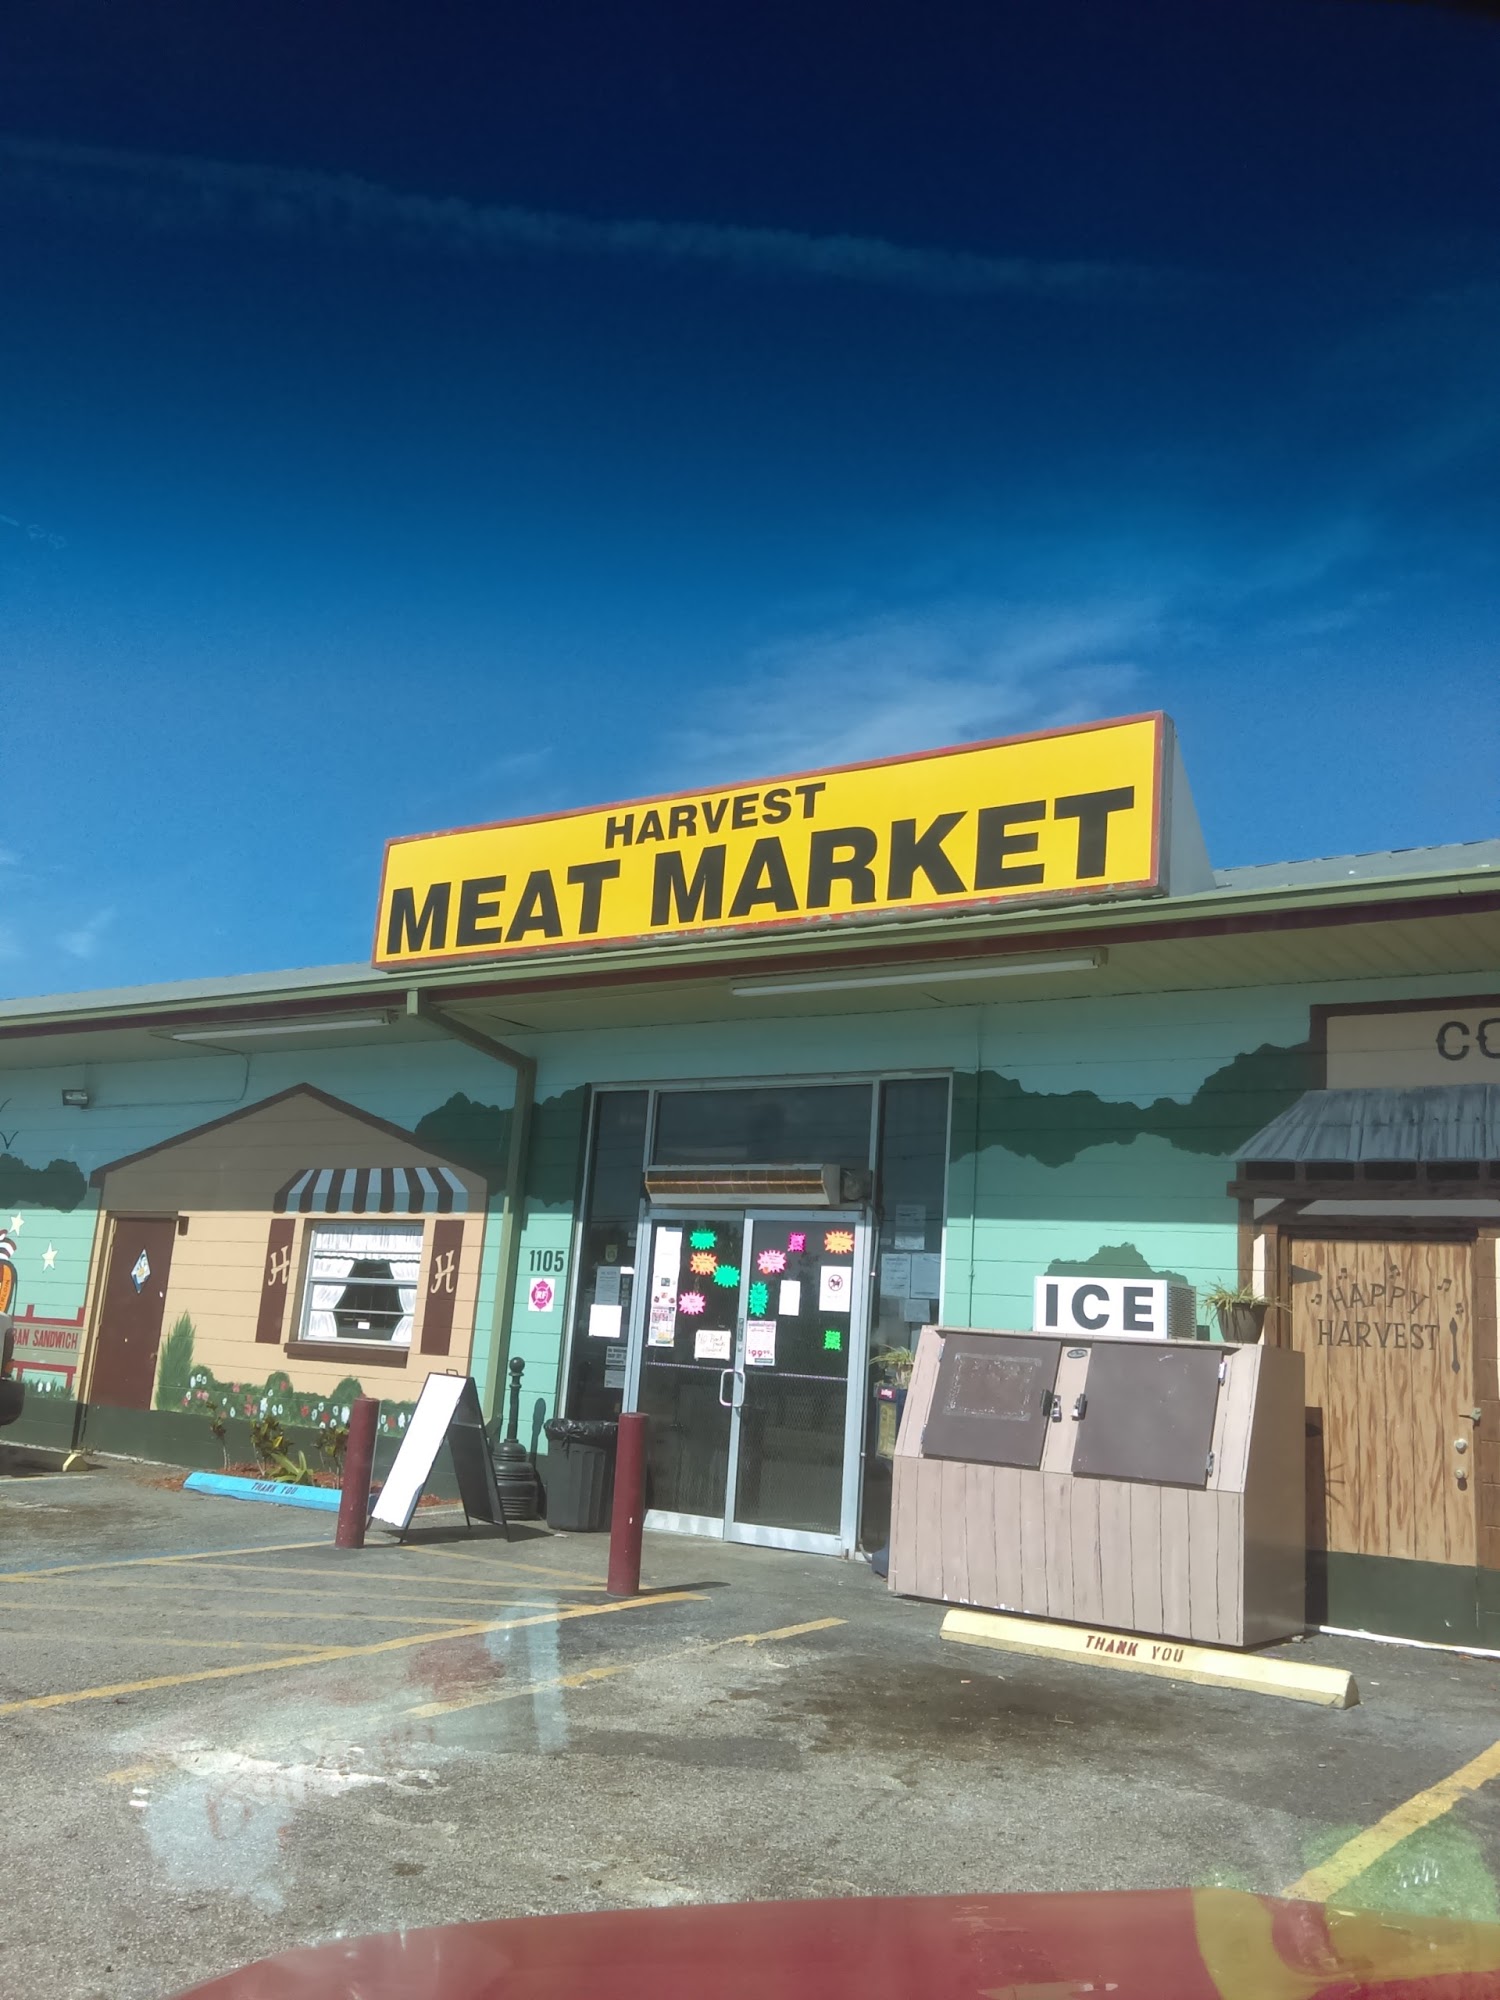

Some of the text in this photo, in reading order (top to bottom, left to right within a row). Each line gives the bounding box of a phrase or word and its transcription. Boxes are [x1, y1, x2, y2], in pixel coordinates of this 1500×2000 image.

[605, 783, 826, 849] HARVEST
[387, 786, 1134, 954] MEAT MARKET
[529, 1250, 565, 1272] 1105
[1045, 1283, 1154, 1332] ICE
[1327, 1283, 1430, 1315] HAPPY
[32, 1329, 79, 1350] SANDWICH
[1317, 1319, 1440, 1350] HARVEST
[251, 1482, 299, 1495] THANK YOU
[1086, 1635, 1184, 1663] THANK YOU
